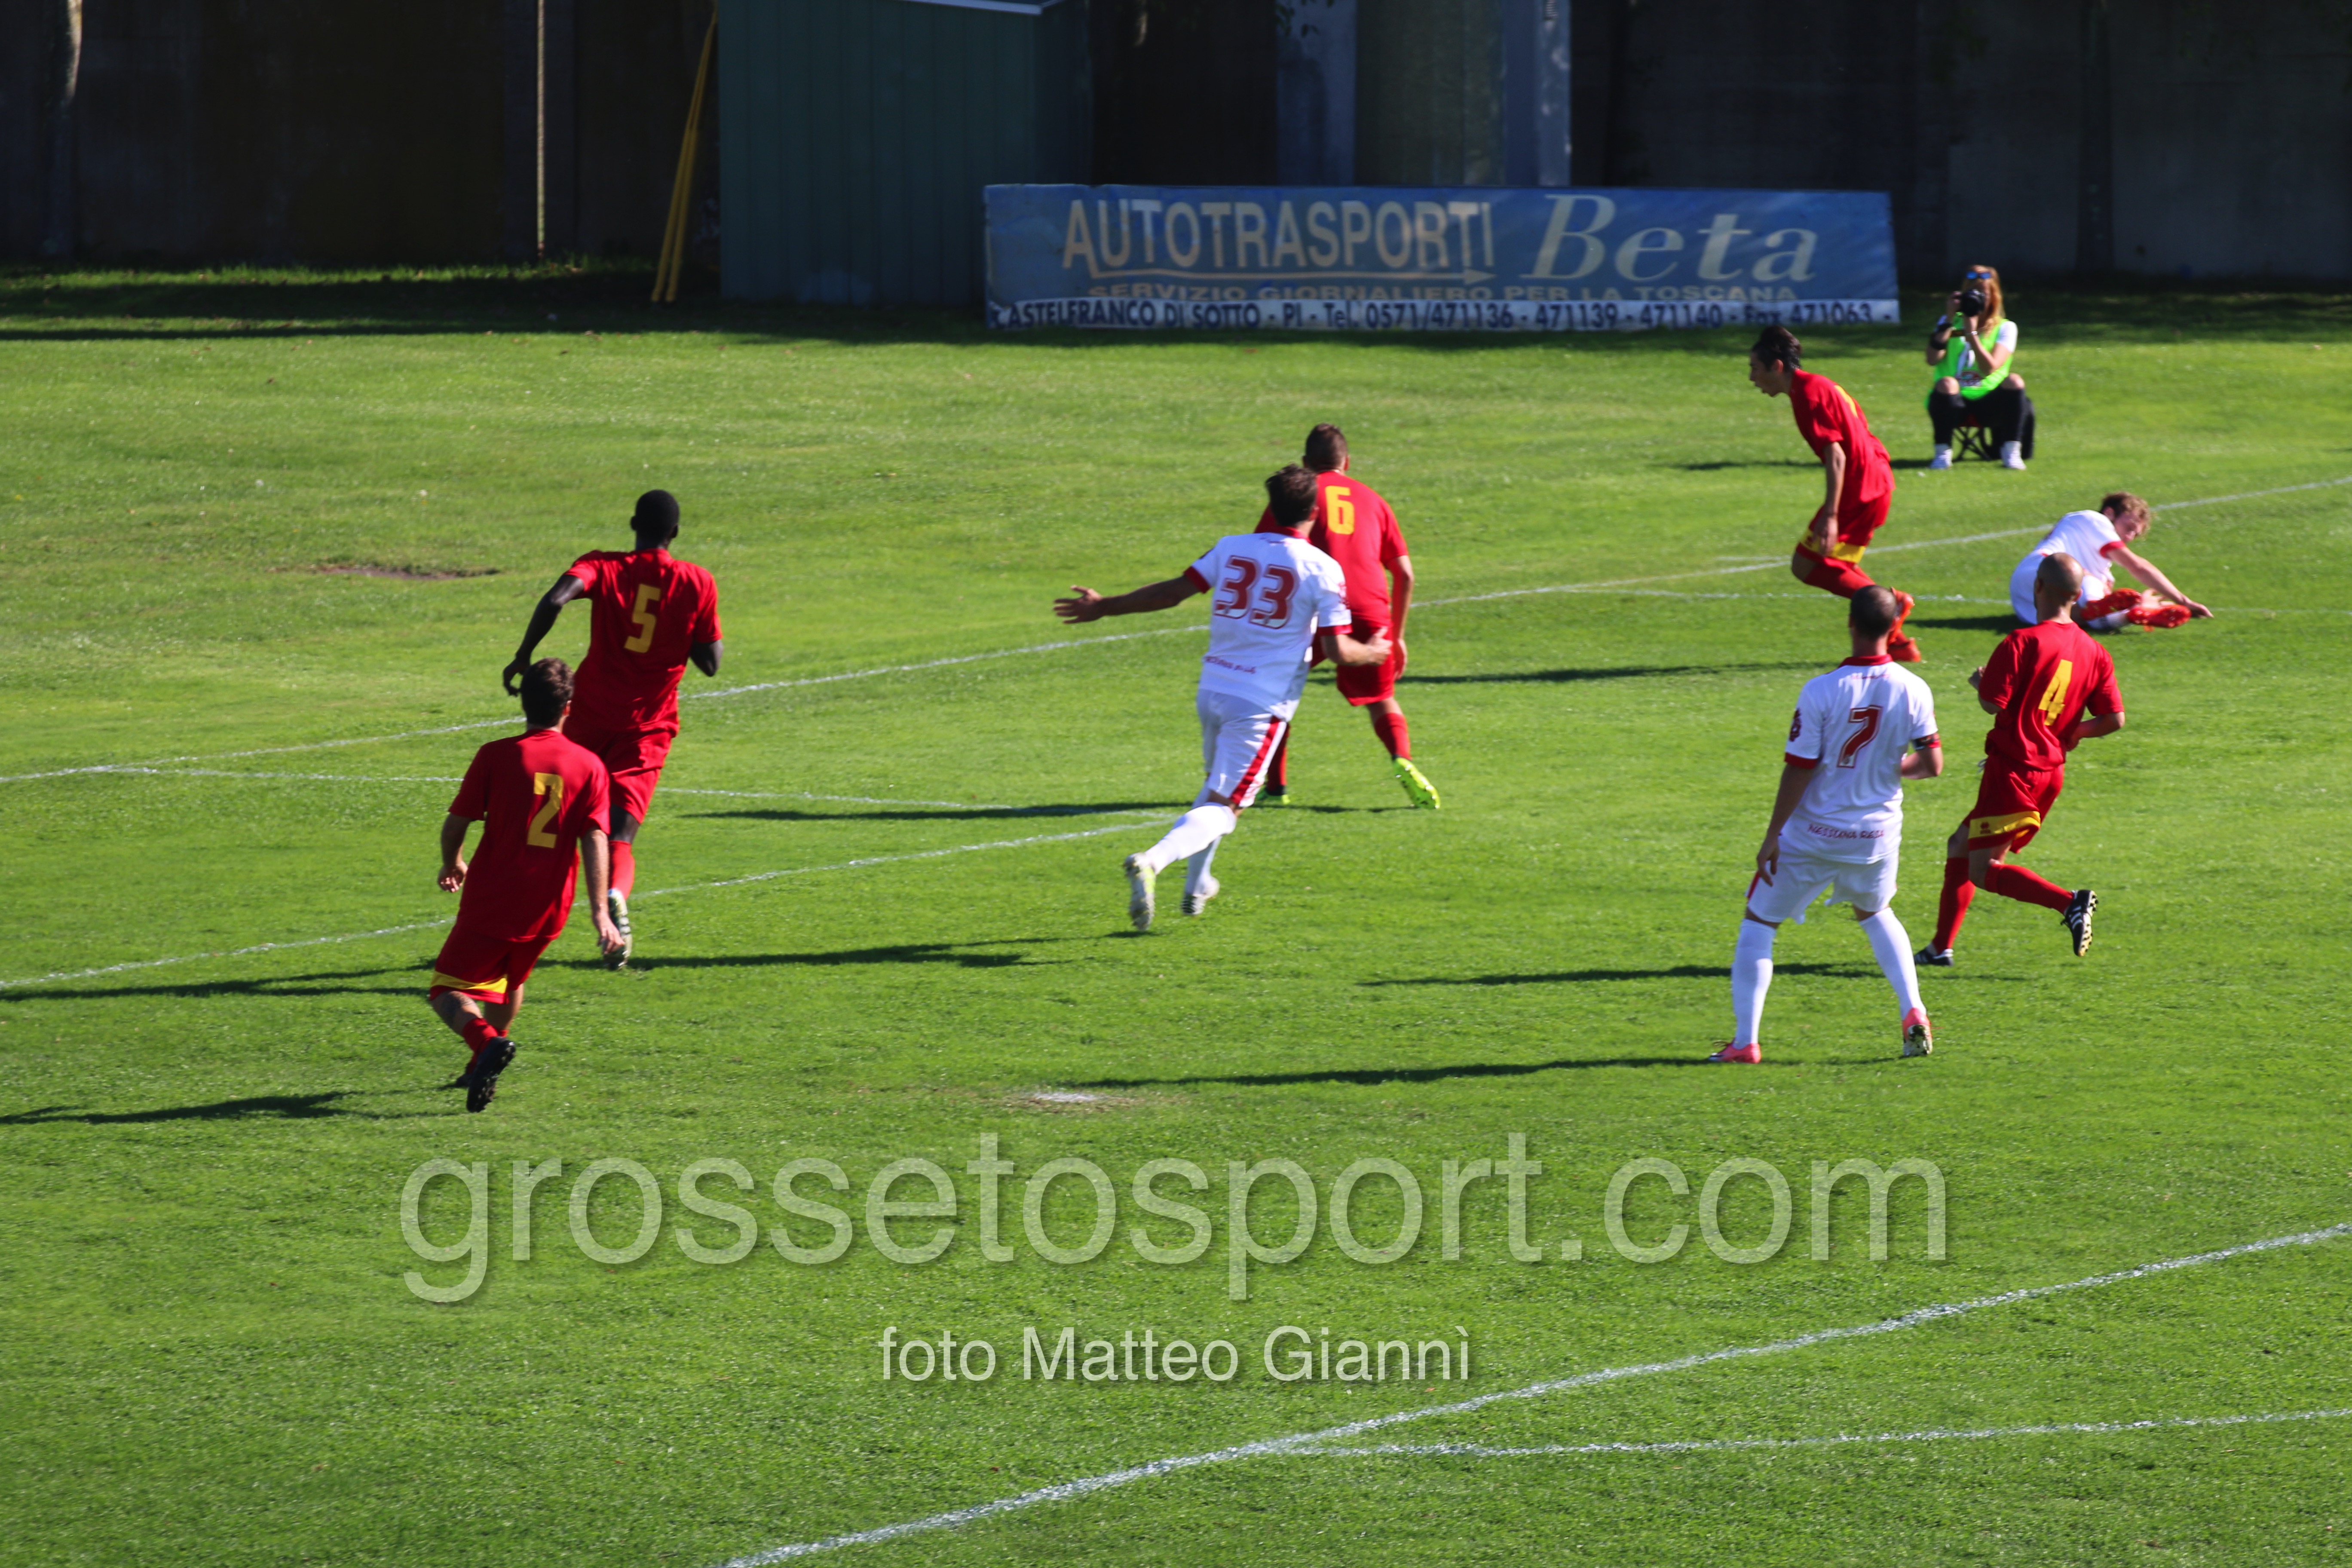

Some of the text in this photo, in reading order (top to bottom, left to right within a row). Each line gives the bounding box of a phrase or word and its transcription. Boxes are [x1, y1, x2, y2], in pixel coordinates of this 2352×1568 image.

[1062, 194, 1819, 282] AUTOTRASPORTI Beta
[1088, 282, 1798, 301] SERVIZIO GIORNALIERO PER LA TOSCANA
[1164, 303, 1184, 327] DI
[1192, 303, 1261, 328] SOTTO
[1282, 303, 1302, 328] PI
[1366, 302, 1513, 329] 0571/471136
[1535, 302, 1618, 328] 471139
[1640, 303, 1722, 328] 471140
[1325, 485, 1355, 535] 6
[624, 583, 661, 653] 5
[1214, 555, 1299, 629] 33
[2038, 659, 2073, 726] 4
[1837, 704, 1883, 769] 7
[527, 772, 564, 848] 2
